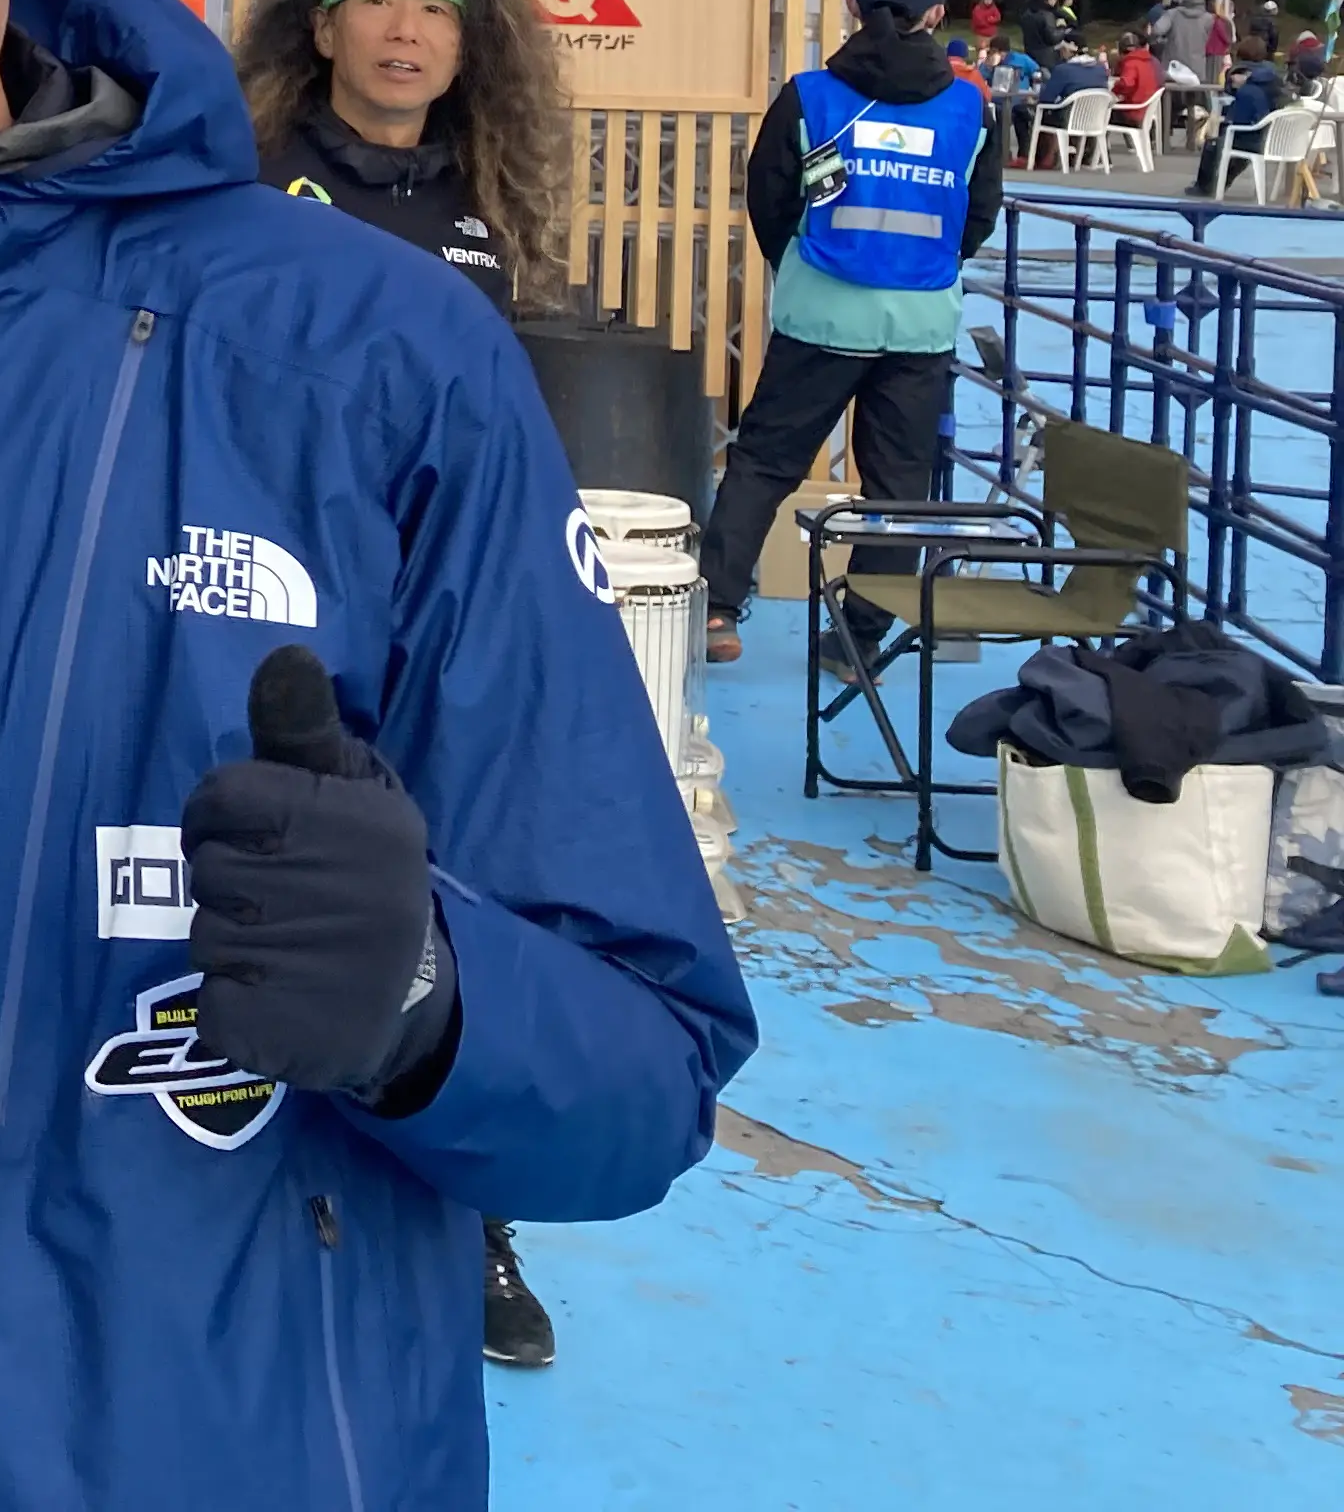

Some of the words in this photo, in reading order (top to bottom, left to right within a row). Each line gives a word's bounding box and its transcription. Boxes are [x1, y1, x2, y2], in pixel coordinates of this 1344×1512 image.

[554, 33, 635, 50] ハイランド
[845, 159, 955, 189] OLUNTEER
[182, 525, 252, 561] THE
[146, 553, 251, 589] NORTH
[170, 583, 250, 619] FACE
[156, 1008, 198, 1025] BUILT
[176, 1091, 222, 1109] TOUGH
[223, 1089, 248, 1102] FOR
